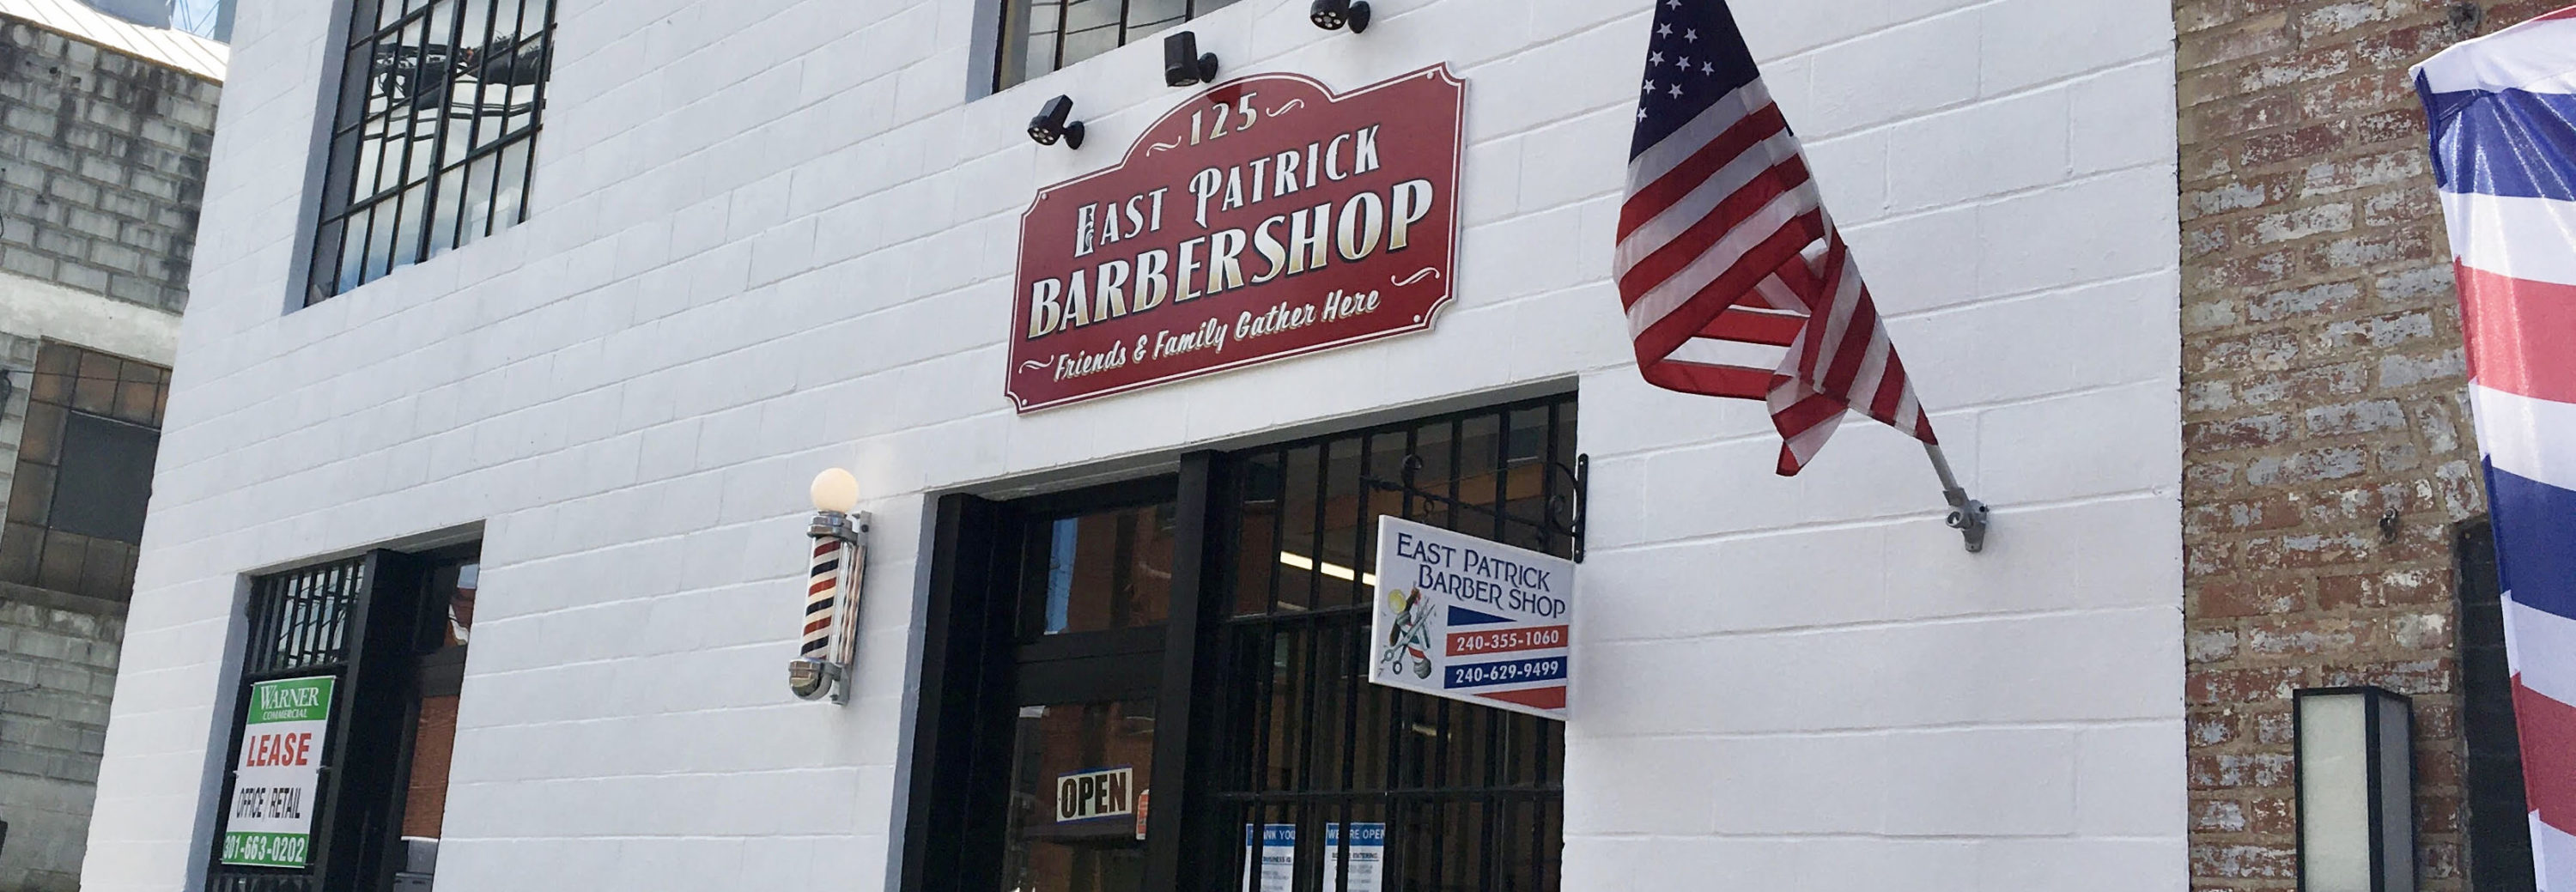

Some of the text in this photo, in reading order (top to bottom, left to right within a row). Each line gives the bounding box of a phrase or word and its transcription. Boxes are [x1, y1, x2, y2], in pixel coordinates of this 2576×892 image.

[1188, 92, 1258, 147] 125
[1074, 124, 1380, 258] EAST PATRICK
[1029, 179, 1434, 339] BARBERSHOP
[1054, 289, 1381, 382] Friends & Family Gather Here
[1396, 532, 1551, 592] EAST PATRICK
[1419, 564, 1566, 618] BARBER SHOP
[1456, 630, 1559, 652] 240-355-1060
[1455, 661, 1558, 683] 240-629-9499
[260, 685, 319, 710] WARNER
[263, 708, 308, 720] COMMERCIAL
[246, 732, 313, 768] LEASE
[236, 787, 266, 818] OFFICE
[269, 787, 301, 819] RETAIL
[1061, 772, 1127, 818] OPEN
[223, 835, 305, 863] 301-663-0202
